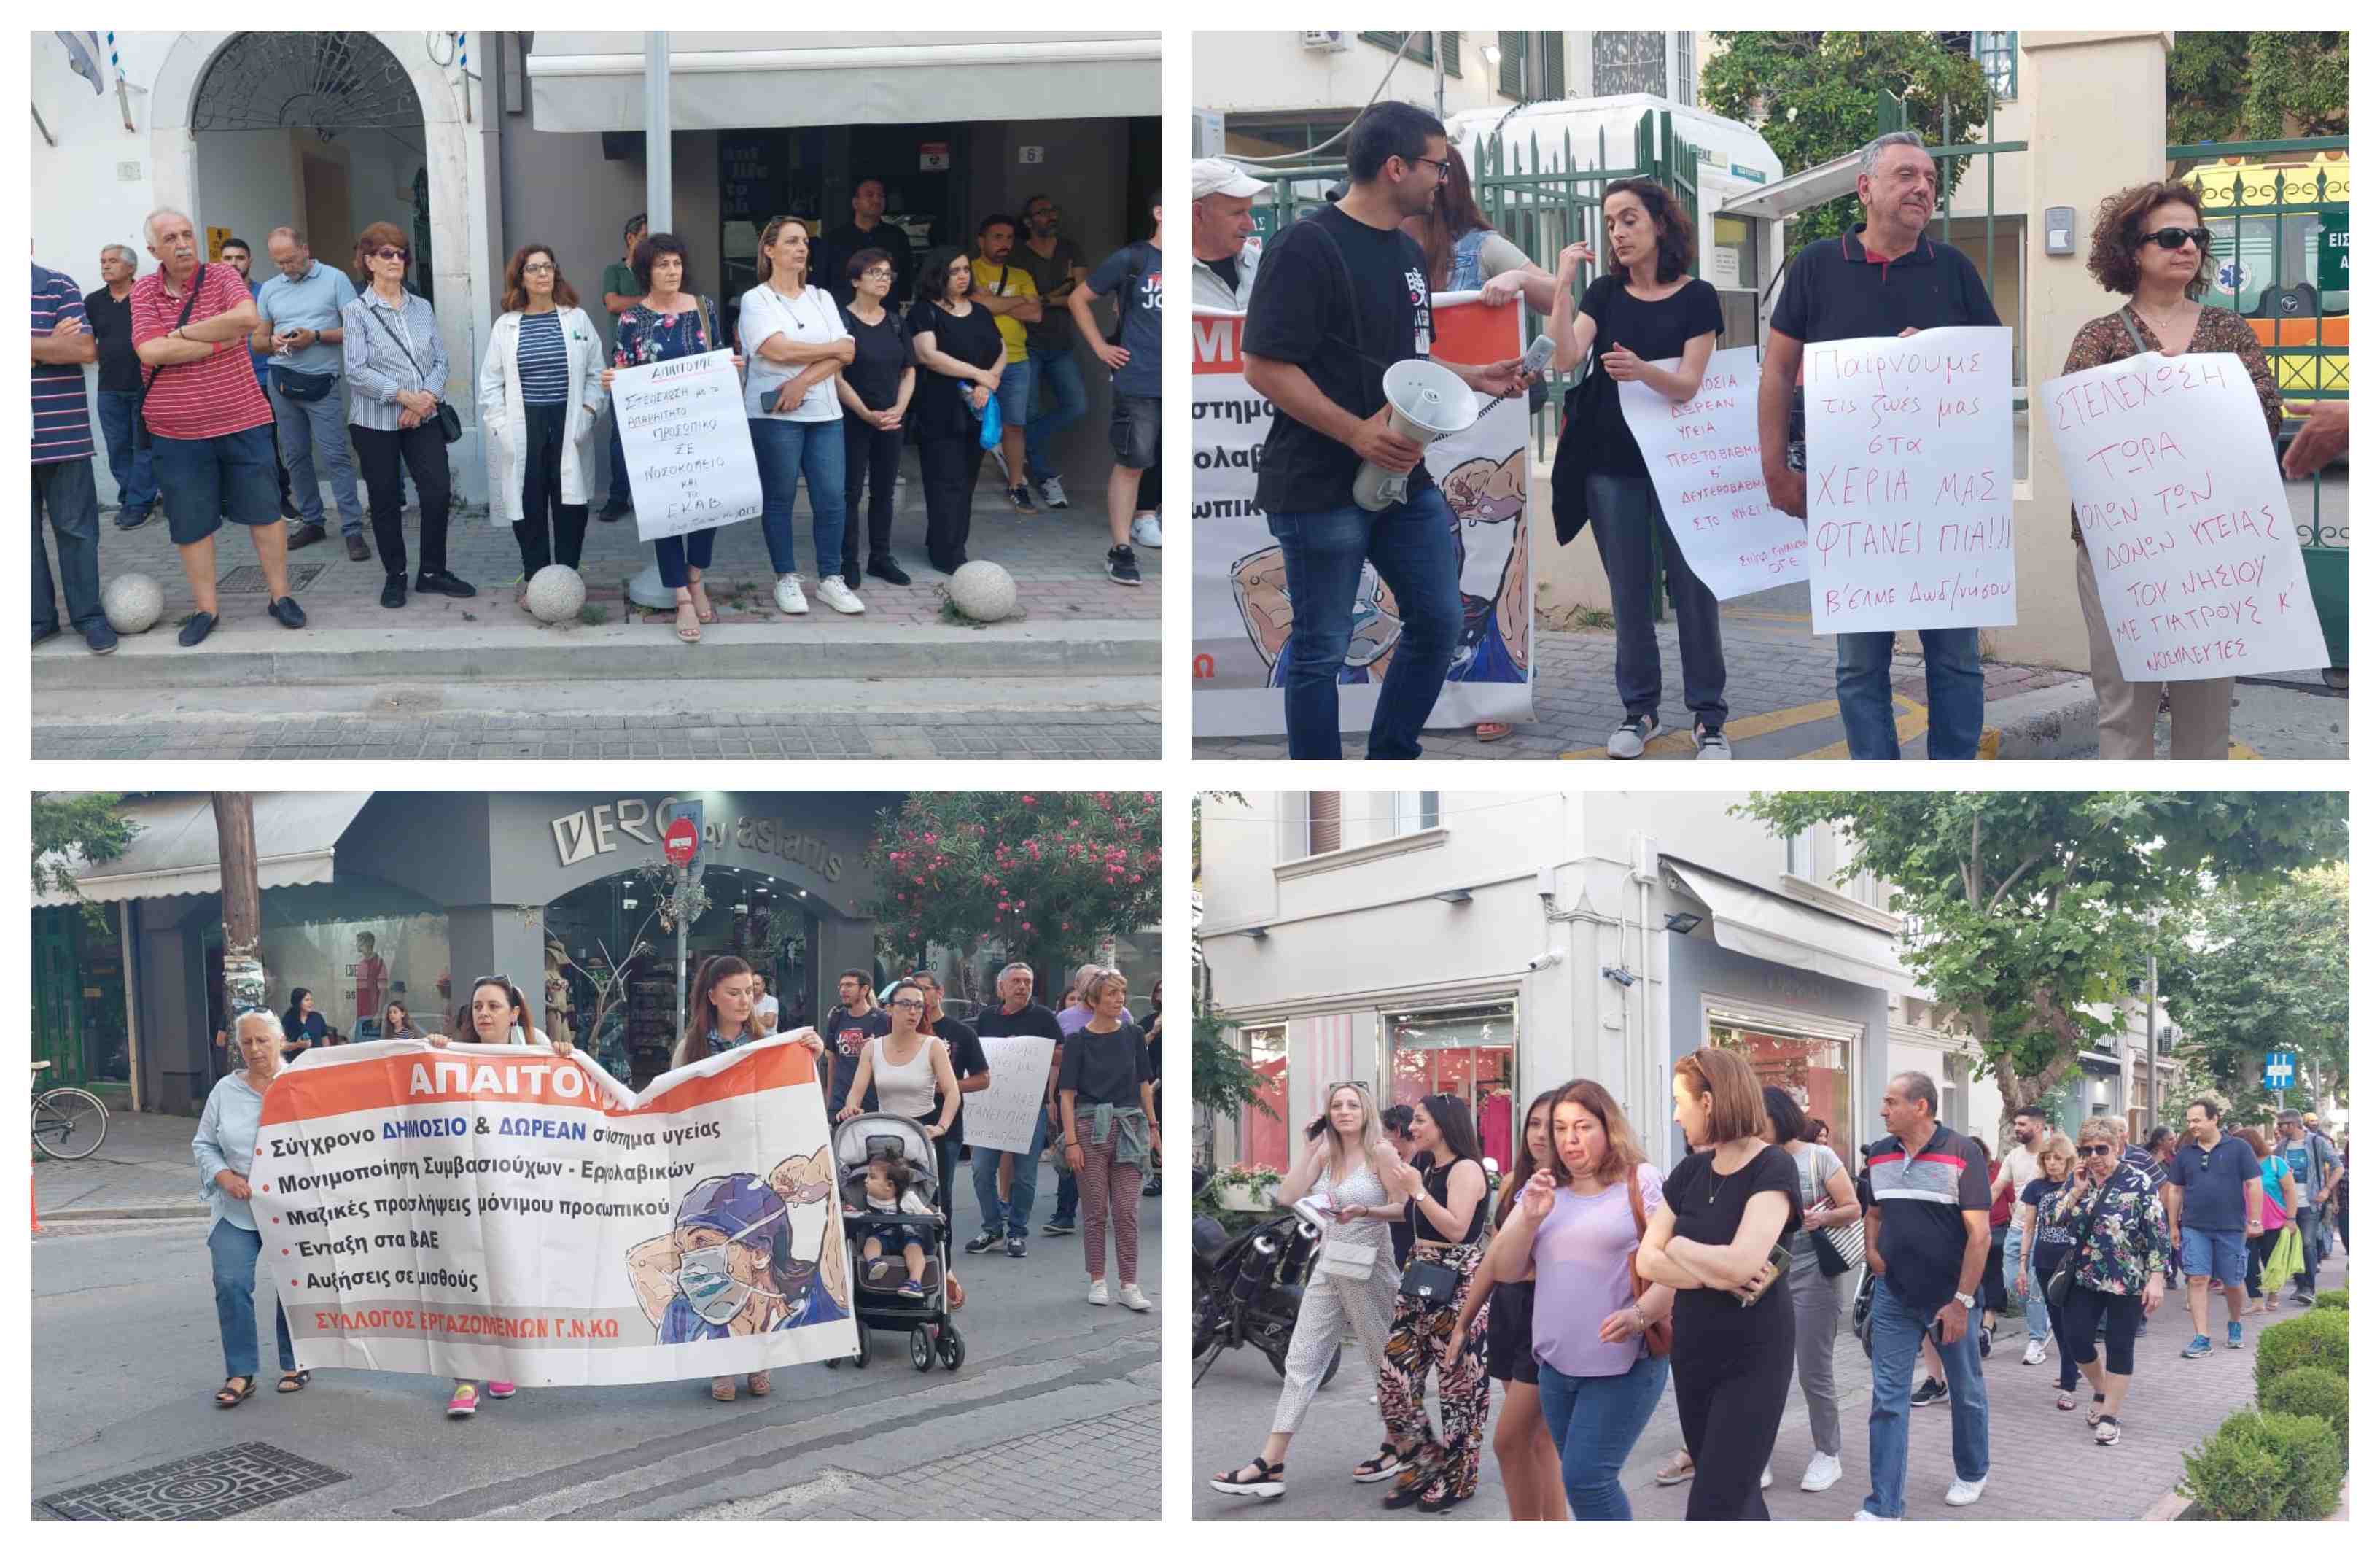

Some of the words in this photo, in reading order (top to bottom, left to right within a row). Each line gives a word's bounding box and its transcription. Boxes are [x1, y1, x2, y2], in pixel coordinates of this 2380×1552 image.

[1026, 147, 1037, 162] 6
[1676, 421, 1716, 441] ΥΓΕΙΑ
[1821, 399, 1857, 414] τις
[1936, 397, 1980, 429] μας
[2086, 431, 2188, 481] ΤΩΡΑ
[1816, 465, 1909, 506] ΧΕΡΙΑ
[1933, 470, 1999, 507] ΜΑΣ
[2153, 469, 2212, 516] ΤΩΝ
[1815, 520, 1922, 567] ΦΤΑΝΕΙ
[2189, 505, 2280, 546] ΥΓΕΙΑΣ
[2126, 580, 2167, 608] ΤΟΥ
[2182, 554, 2266, 596] ΝΗΣΙΟΥ
[2116, 618, 2142, 643] ΜΕ
[2150, 595, 2263, 636] ΓΙΑΤΡΟΥΣ
[271, 1129, 376, 1158] Σύγχρονο
[382, 1117, 467, 1140] ΔΗΜΟΣΙΟ
[475, 1116, 491, 1135] &
[498, 1117, 587, 1141] ΔΩΡΕΑΝ
[593, 1126, 656, 1150] σύστημα
[663, 1121, 721, 1146] υγείας
[278, 1158, 420, 1195] Μονιμοποίηση
[423, 1156, 563, 1179] Συμβασιούχων
[581, 1160, 695, 1184] Εργολαβικών
[286, 1200, 370, 1226] Μαζικές
[374, 1194, 472, 1217] προσλήψεις
[478, 1192, 553, 1216] μόνιμου
[559, 1198, 670, 1219] προσωπικού
[295, 1235, 369, 1257] Ένταξη
[374, 1233, 406, 1249] στα
[409, 1230, 440, 1249] ΒΑΕ
[307, 1270, 391, 1292] Αυξήσεις
[394, 1270, 414, 1284] σε
[417, 1268, 478, 1292] μισθούς
[315, 1309, 416, 1330] ΣΥΛΛΟΓΟΣ
[420, 1312, 549, 1338] ΕΡΓΑΖΟΜΕΝΩΝ
